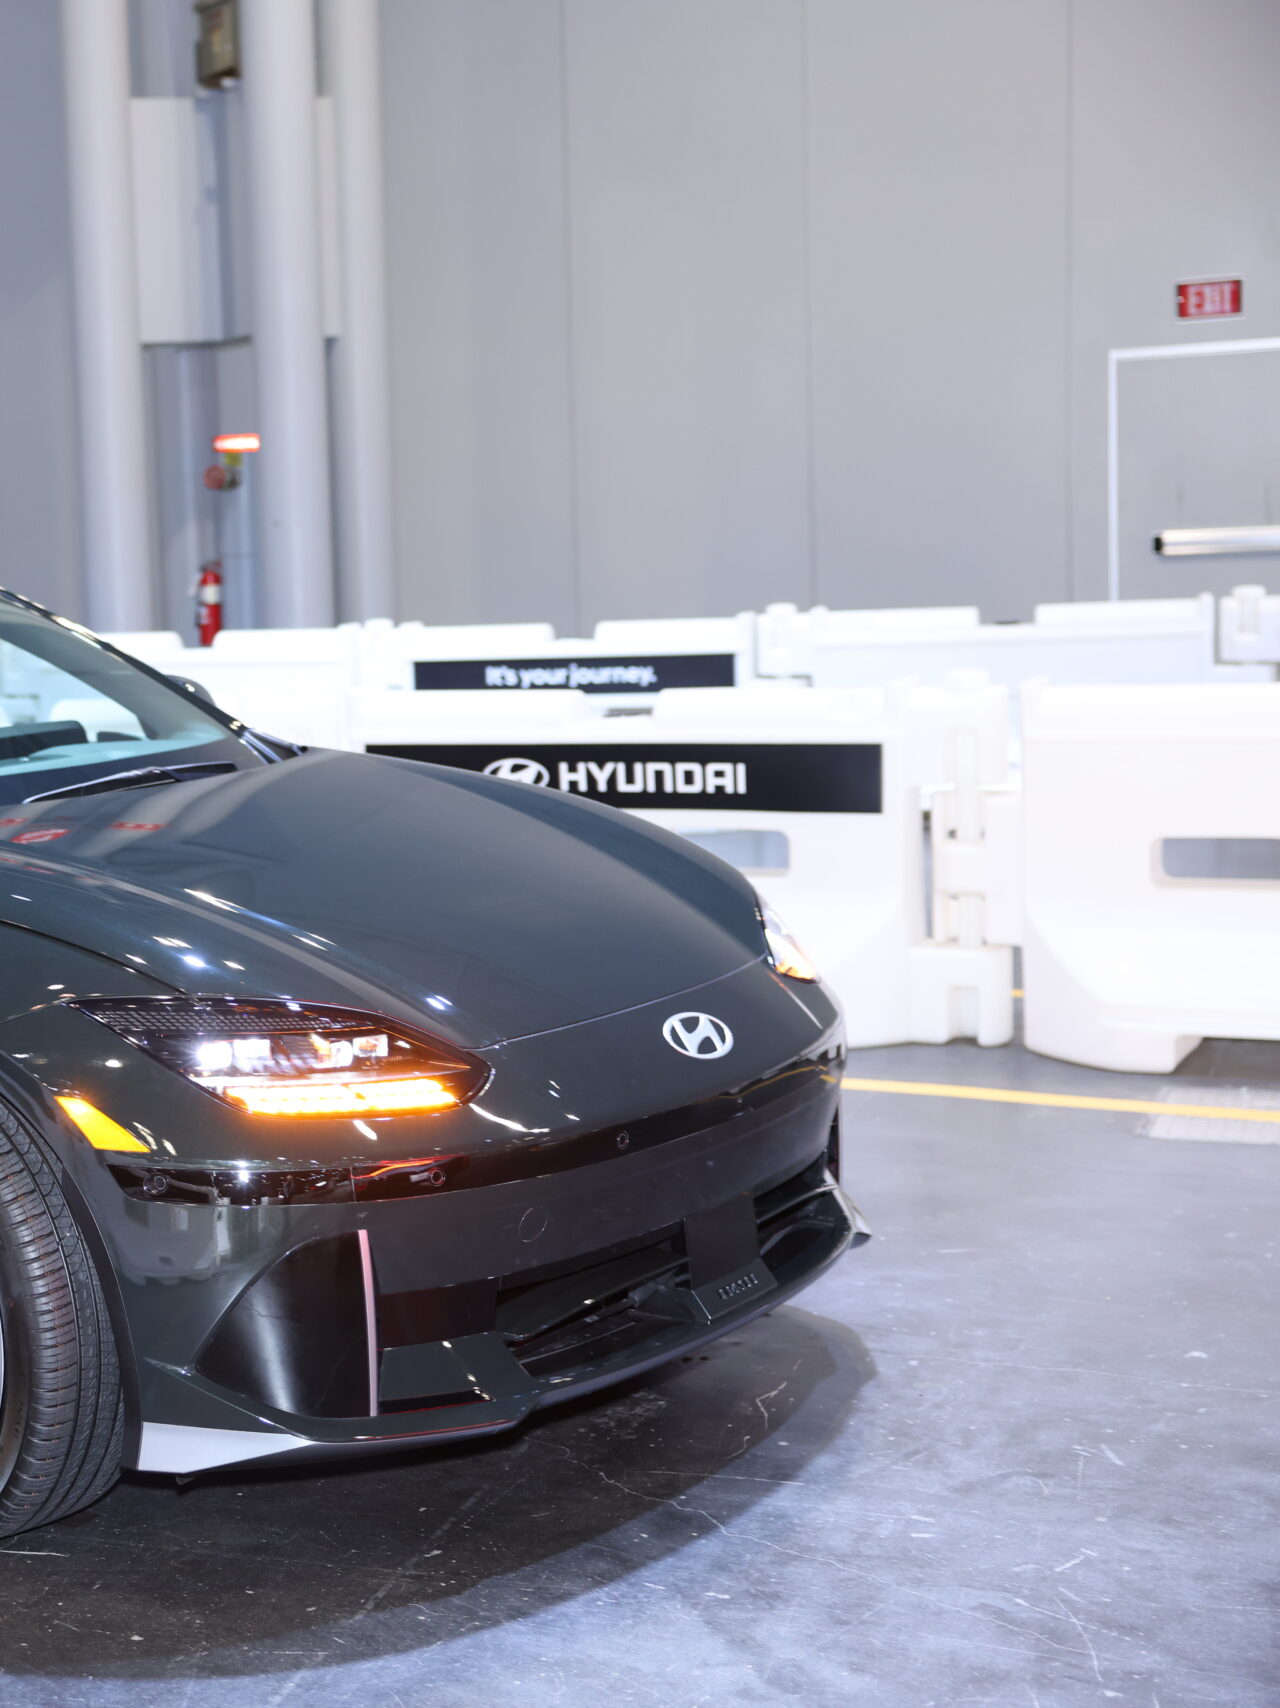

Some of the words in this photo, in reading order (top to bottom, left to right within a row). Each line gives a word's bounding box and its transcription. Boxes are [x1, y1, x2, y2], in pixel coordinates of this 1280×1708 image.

[485, 666, 518, 686] It's
[520, 667, 568, 689] your
[568, 662, 658, 688] journey.
[558, 761, 746, 794] HYUNDAI
